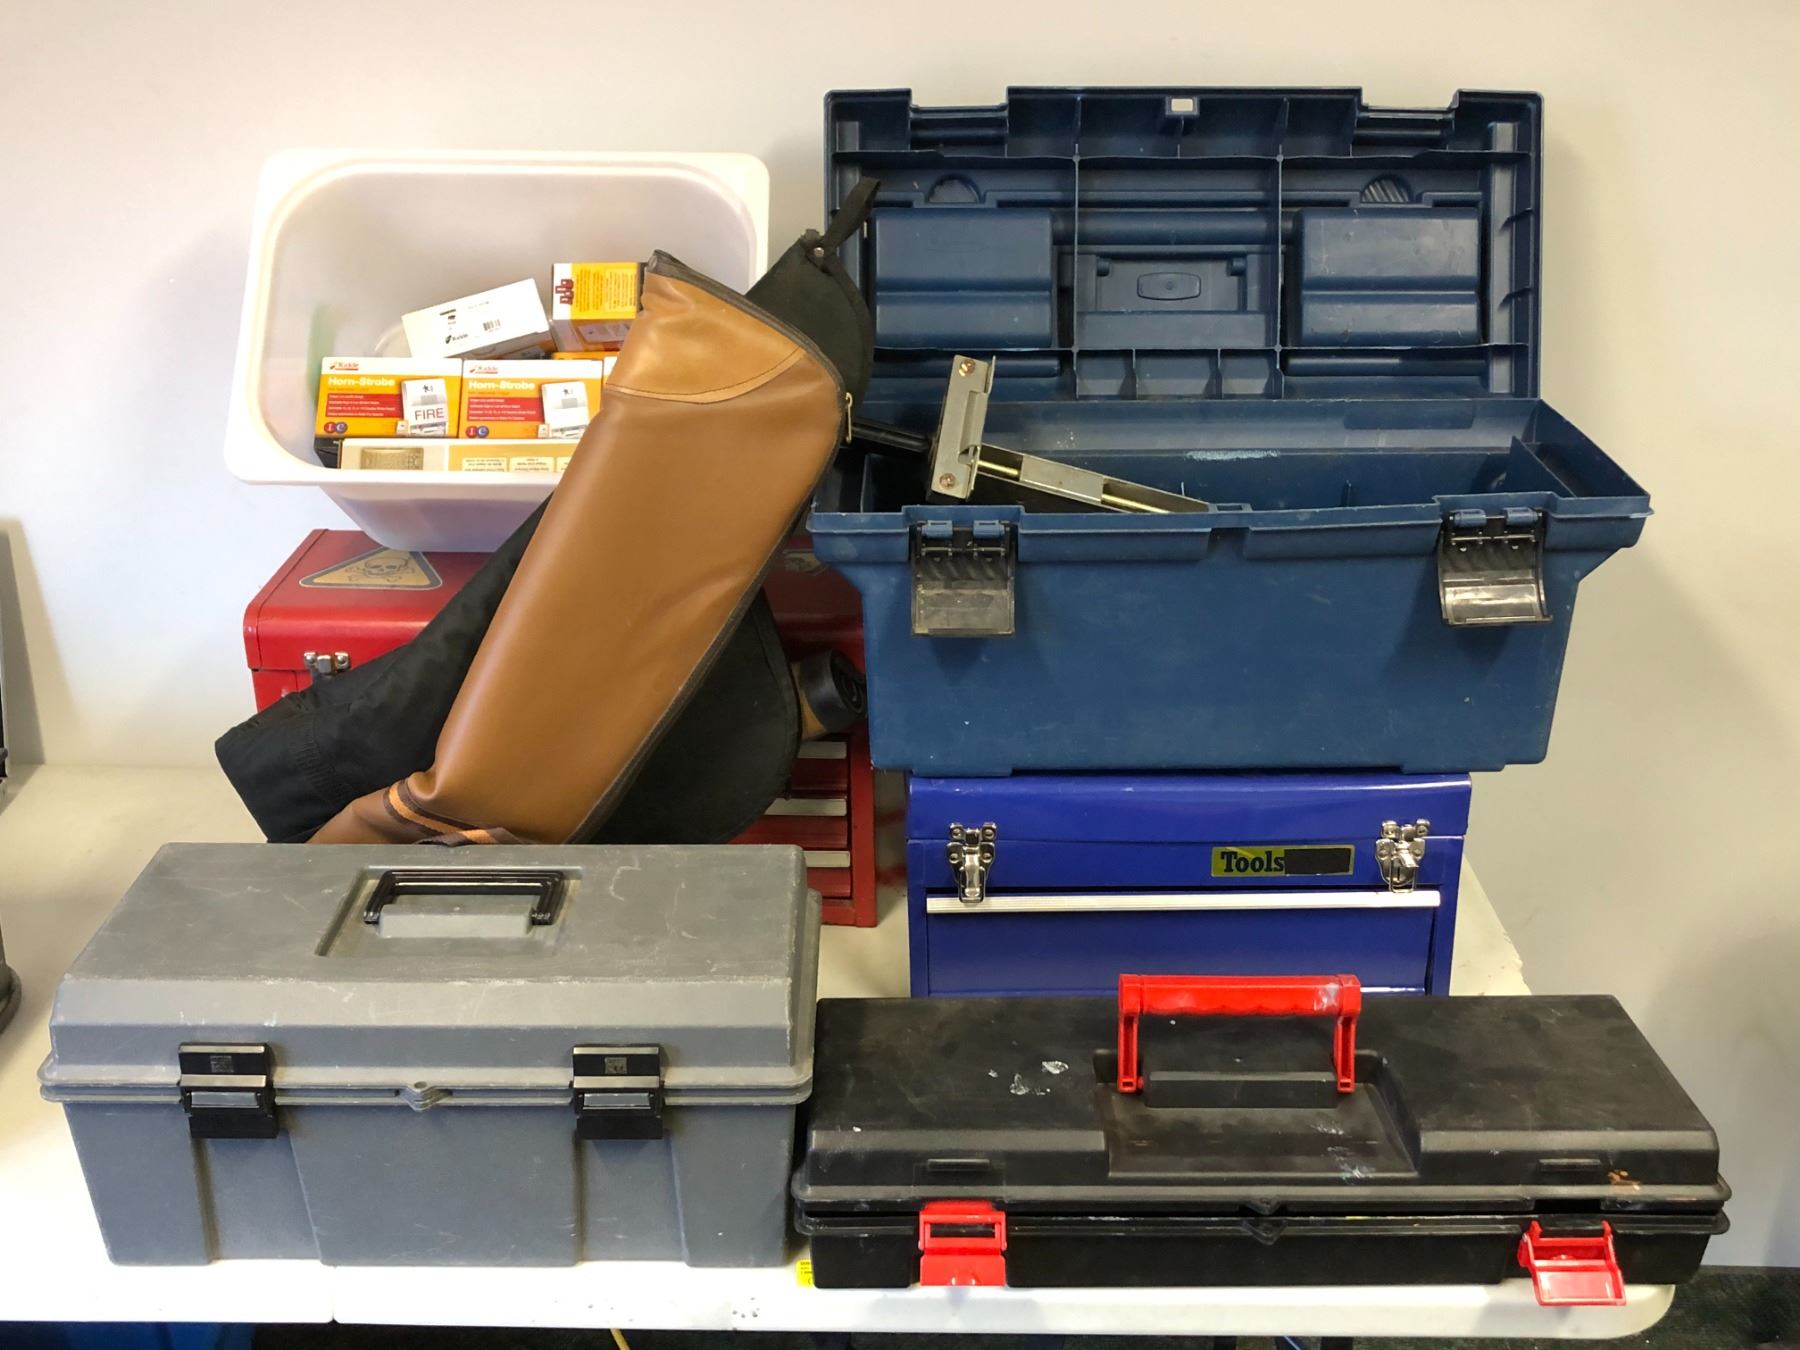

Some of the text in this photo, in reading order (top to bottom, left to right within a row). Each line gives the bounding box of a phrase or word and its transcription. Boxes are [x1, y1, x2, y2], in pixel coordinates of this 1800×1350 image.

[327, 376, 396, 387] Horn-Strobe
[467, 380, 536, 391] Horn-Strobe
[414, 407, 445, 421] FIRE
[1220, 850, 1285, 873] Tools
